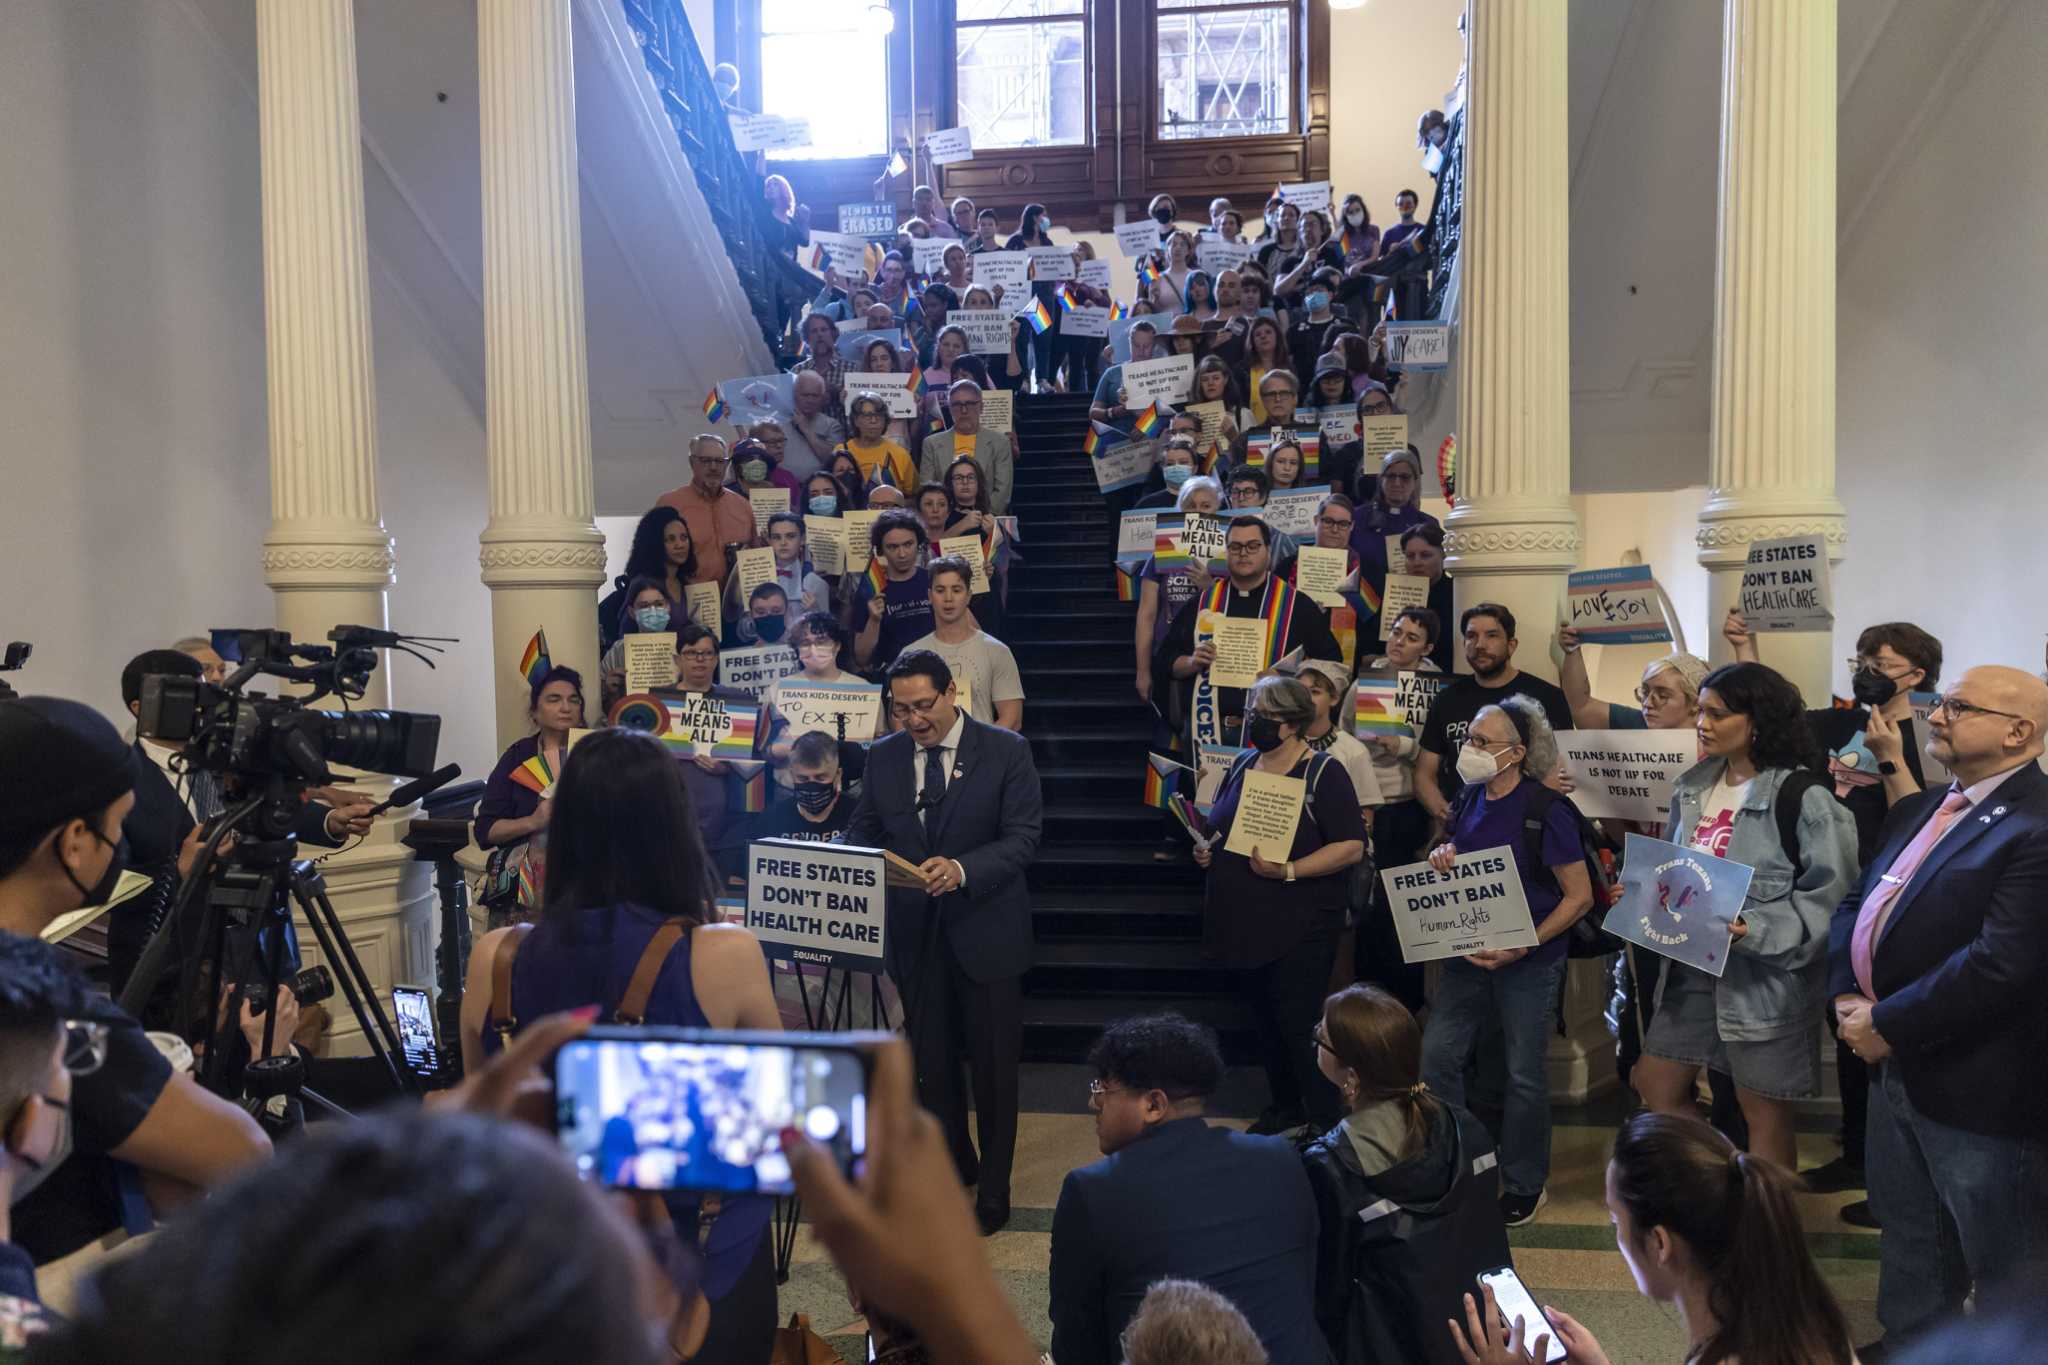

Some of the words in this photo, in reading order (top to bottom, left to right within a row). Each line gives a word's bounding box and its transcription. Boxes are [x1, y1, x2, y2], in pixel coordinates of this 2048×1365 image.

[841, 216, 893, 234] ERASED
[951, 312, 972, 321] FREE
[975, 312, 1006, 321] STATES
[1128, 371, 1148, 381] TRANS
[1149, 365, 1188, 377] HEALTHCARE
[1149, 386, 1171, 395] DEBATE
[1187, 518, 1221, 535] Y'ALL
[1181, 531, 1225, 547] MEANS
[1189, 544, 1214, 559] ALL
[1766, 544, 1817, 562] STATES
[1743, 571, 1777, 588] DON'T
[1782, 568, 1813, 585] BAN
[1572, 589, 1614, 622] LOVE
[1616, 597, 1650, 622] JOY
[725, 654, 761, 668] FREE
[731, 668, 776, 683] DON'T
[1401, 677, 1438, 694] Y'ALL
[782, 690, 808, 699] TRANS
[810, 691, 830, 701] KIDS
[688, 698, 727, 715] Y'ALL
[779, 701, 802, 713] TO
[680, 712, 731, 730] MEANS
[1405, 710, 1425, 726] AL
[690, 728, 719, 744] ALL
[1568, 750, 1605, 761] TRANS
[1607, 751, 1684, 764] HEALTHCARE
[1589, 767, 1600, 777] IS
[1601, 768, 1622, 778] NOT
[1625, 770, 1639, 780] UP
[1644, 770, 1665, 781] FOR
[1608, 785, 1650, 798] DEBATE
[756, 857, 803, 880] FREE
[805, 862, 877, 888] STATES
[1393, 870, 1437, 891] FREE
[1440, 857, 1505, 883] STATES
[763, 885, 822, 908] DON'T
[826, 892, 868, 914] BAN
[1407, 890, 1460, 912] DON'T
[1465, 882, 1506, 903] BAN
[750, 910, 822, 936] HEALTH
[827, 919, 881, 944] CARE
[1419, 916, 1460, 937] Human
[1459, 906, 1491, 936] Rights
[1452, 940, 1485, 953] EQUALITY
[792, 949, 833, 964] EQUALITY
